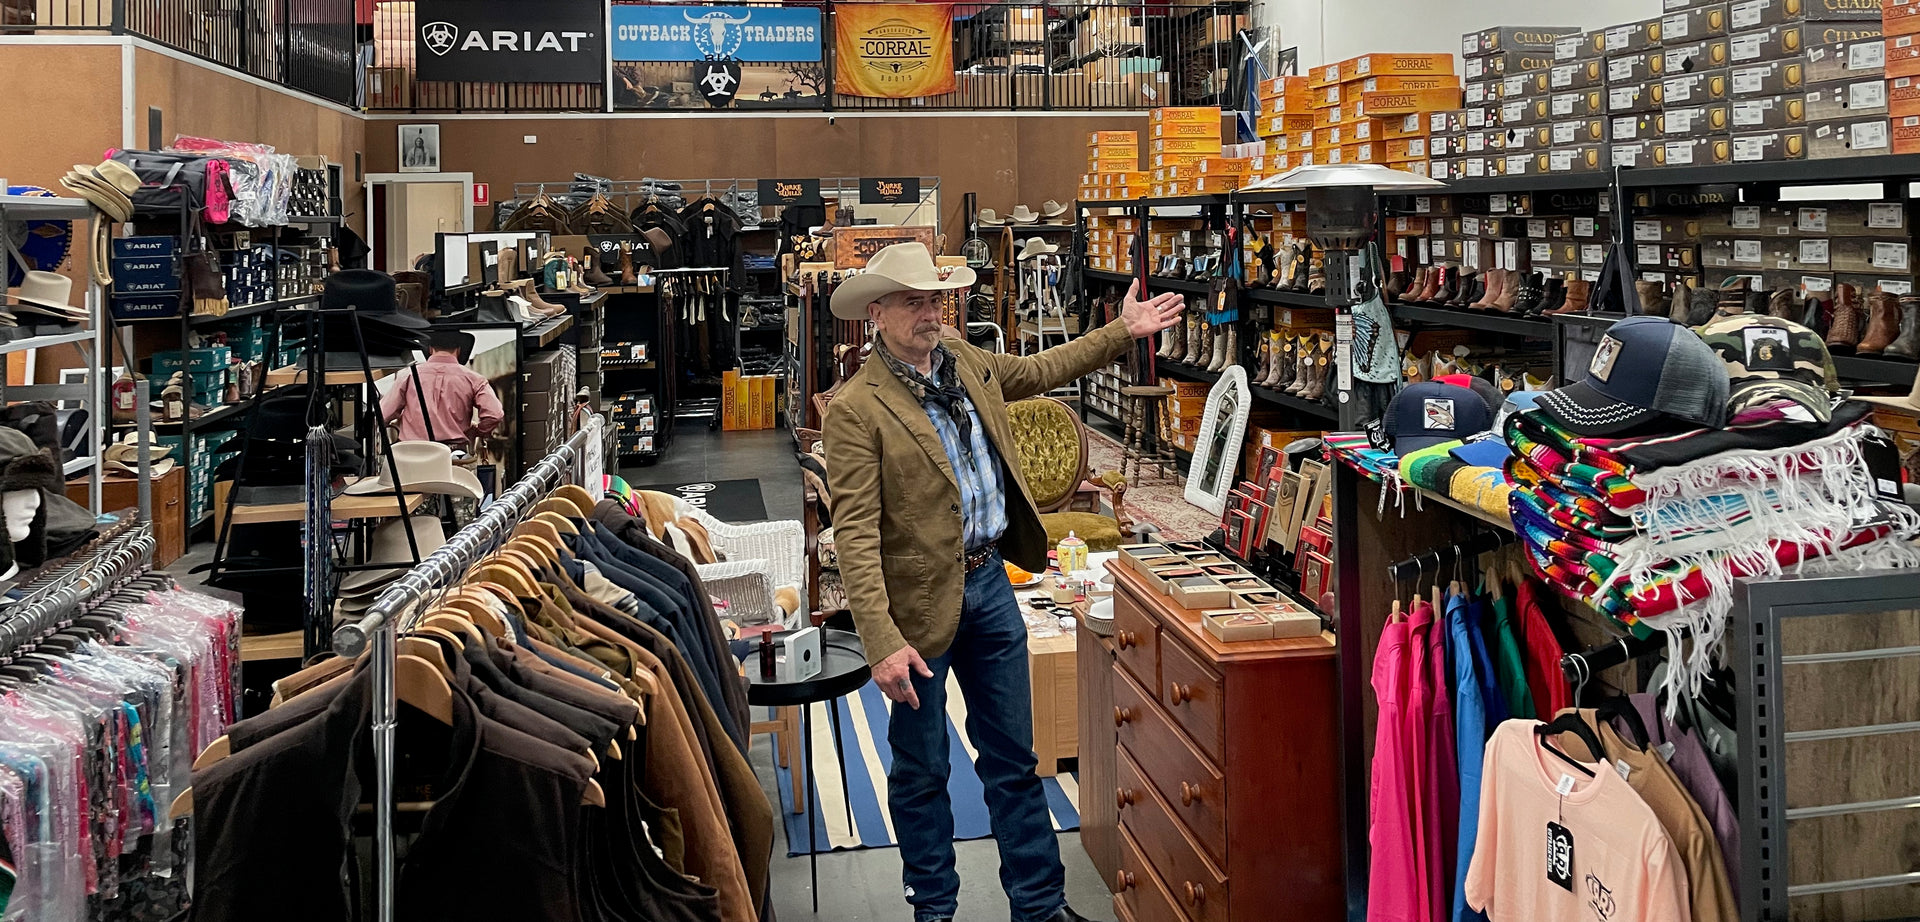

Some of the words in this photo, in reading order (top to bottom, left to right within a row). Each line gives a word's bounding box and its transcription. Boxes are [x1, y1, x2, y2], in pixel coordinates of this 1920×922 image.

[618, 25, 691, 41] OUTBACK
[744, 26, 815, 42] TRADERS
[460, 30, 587, 51] ARIAT
[865, 41, 928, 55] CORRAL
[1395, 60, 1428, 69] CORRAL
[880, 74, 912, 82] BOOTS
[1373, 97, 1412, 107] CORRAL
[1291, 120, 1313, 128] CORR
[1227, 163, 1243, 171] COR
[1224, 181, 1239, 189] COR
[1551, 194, 1596, 207] CUAD
[1667, 193, 1725, 205] CUADRA
